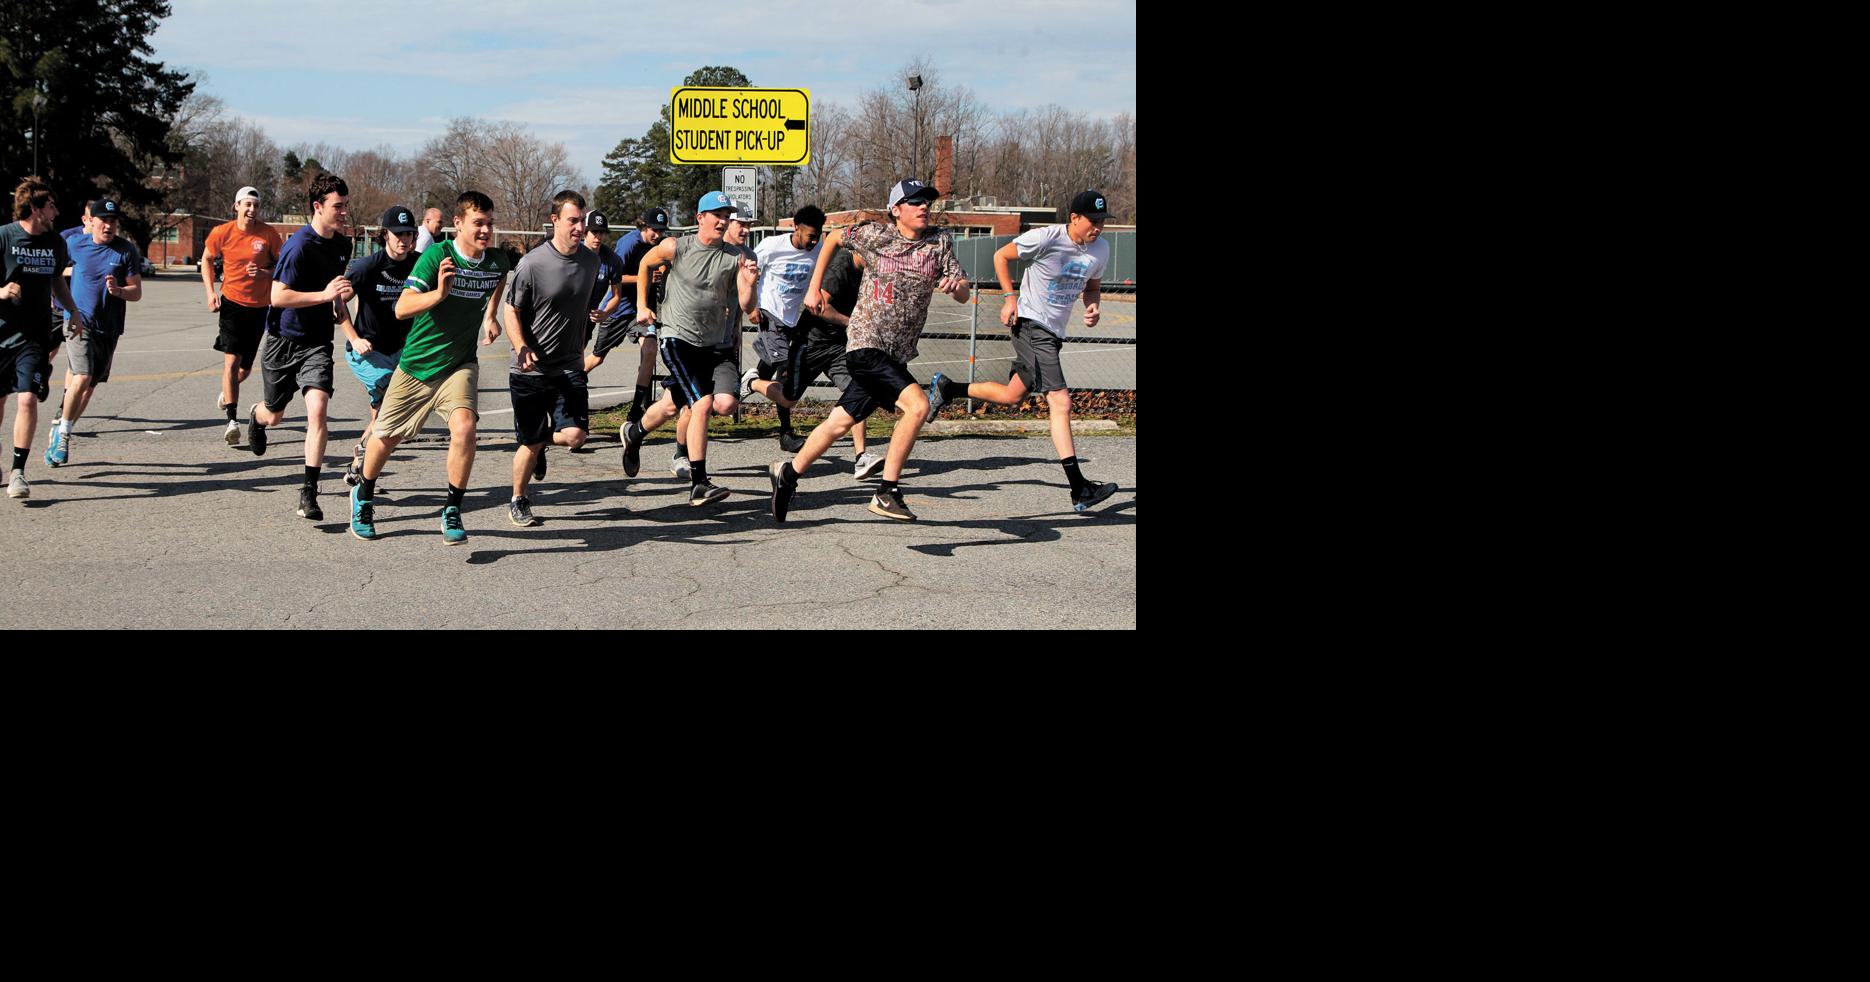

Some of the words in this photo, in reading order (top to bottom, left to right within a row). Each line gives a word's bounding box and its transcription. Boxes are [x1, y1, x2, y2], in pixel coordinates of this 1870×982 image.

[678, 98, 728, 119] MIDDLE
[732, 98, 786, 119] SCHOOL
[675, 129, 731, 150] STUDENT
[735, 130, 785, 151] PICK-UP
[734, 174, 746, 184] NO
[11, 246, 54, 258] HALIFAX
[16, 255, 56, 267] COMETS
[873, 278, 894, 305] 14
